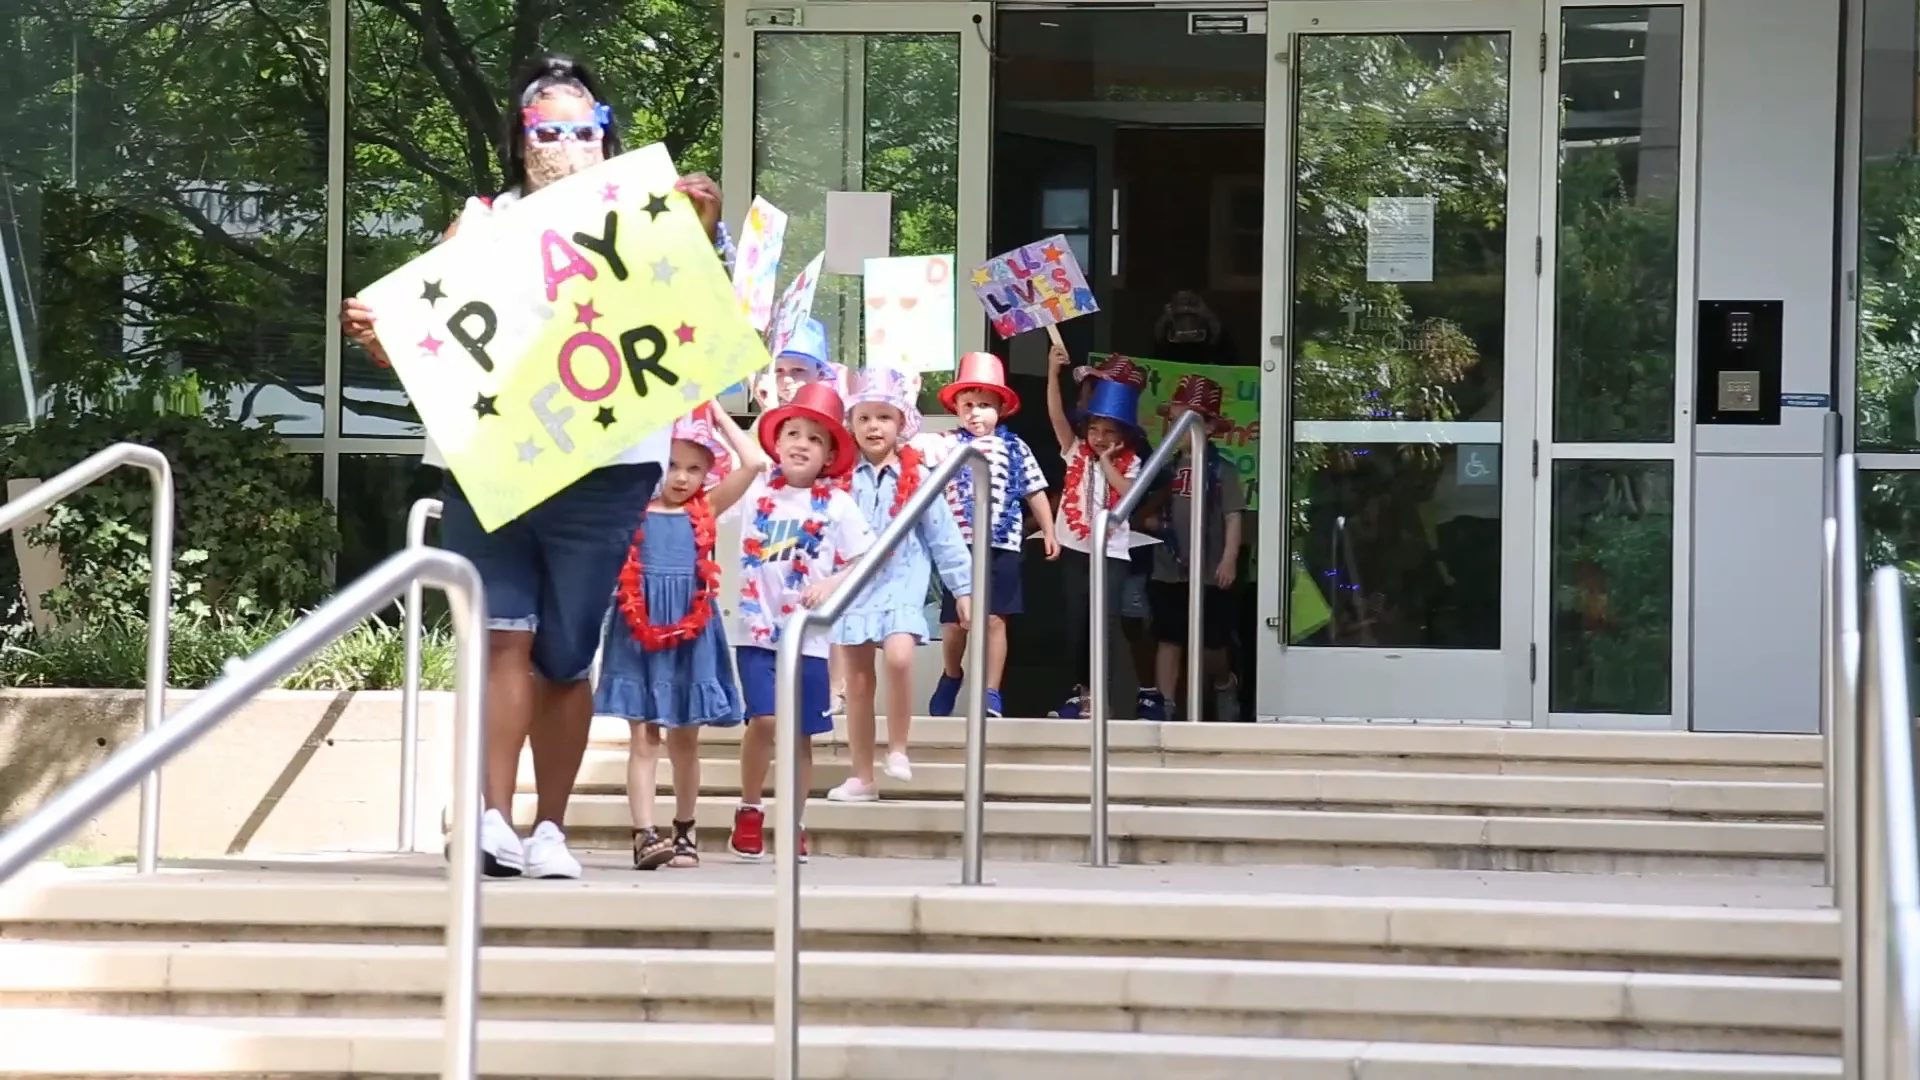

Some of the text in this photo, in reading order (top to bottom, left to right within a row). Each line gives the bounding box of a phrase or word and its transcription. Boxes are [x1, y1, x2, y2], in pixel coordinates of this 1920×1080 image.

[447, 210, 629, 373] PAY
[986, 267, 1072, 315] LIVES
[529, 324, 680, 454] FOR
